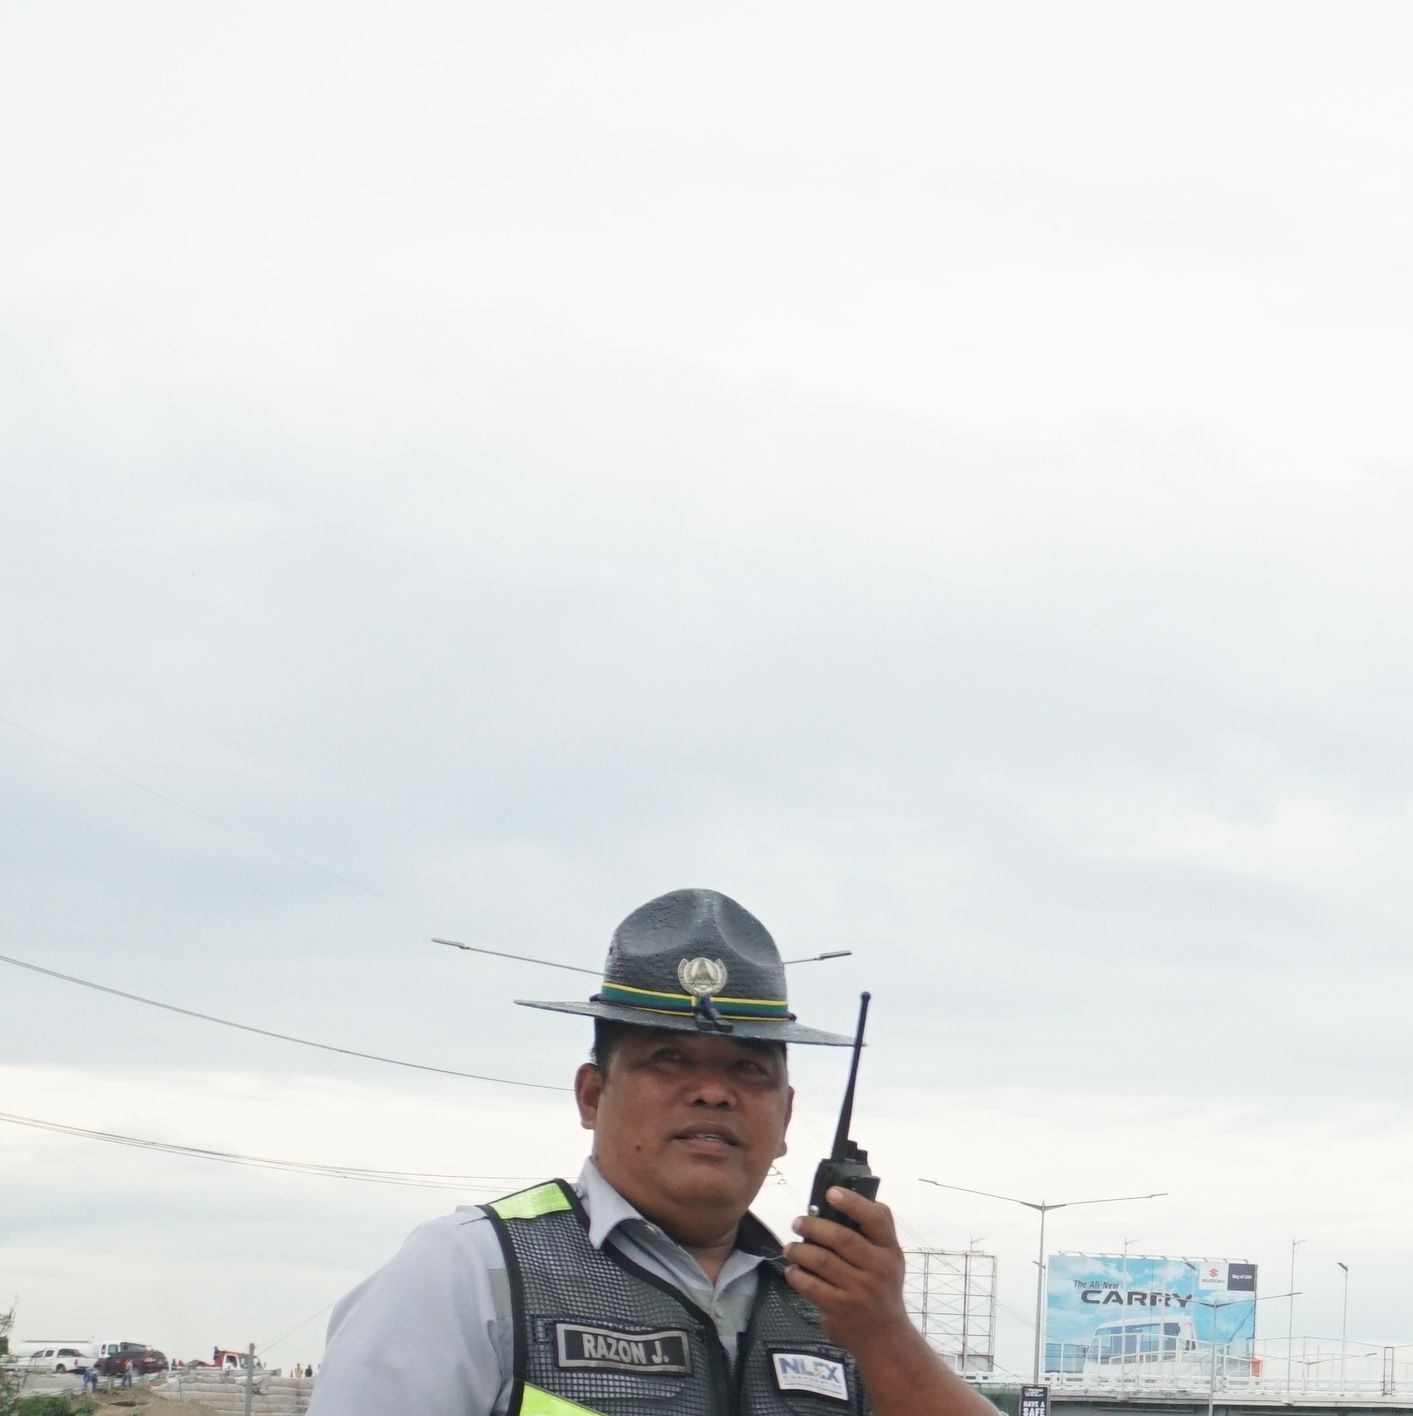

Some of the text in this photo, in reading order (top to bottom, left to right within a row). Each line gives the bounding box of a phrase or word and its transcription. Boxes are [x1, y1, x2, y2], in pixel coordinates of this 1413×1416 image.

[1073, 1279, 1120, 1290] The All-New
[1081, 1289, 1193, 1307] CARRY
[582, 1334, 669, 1365] RAZON J.
[778, 1357, 841, 1384] NLEX
[1022, 1407, 1045, 1416] SAFE
